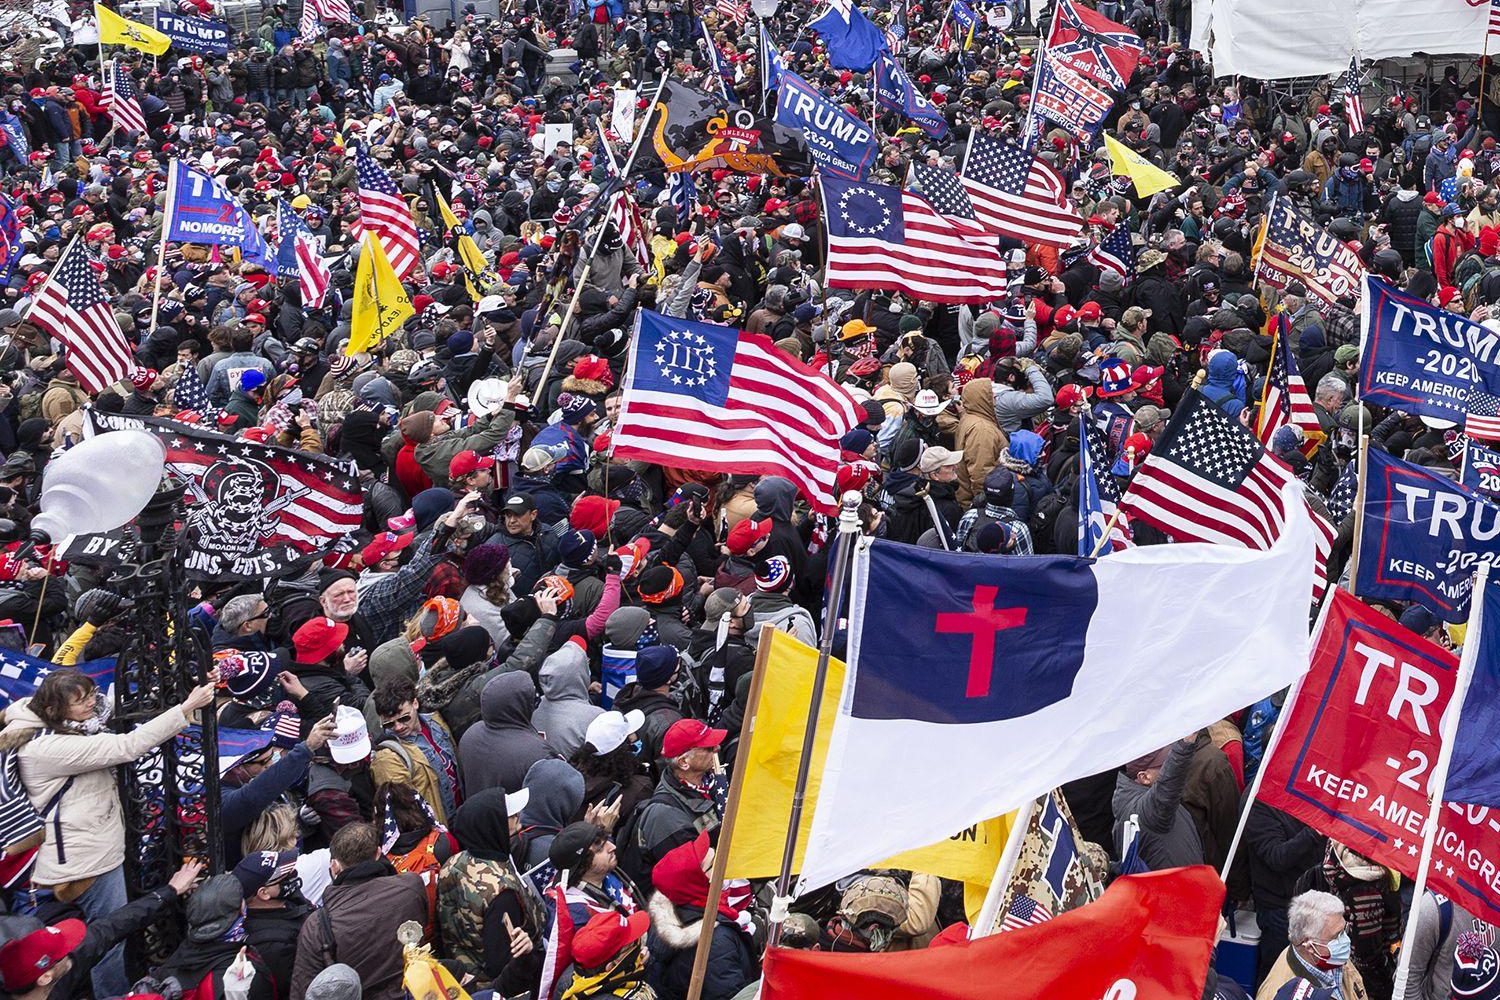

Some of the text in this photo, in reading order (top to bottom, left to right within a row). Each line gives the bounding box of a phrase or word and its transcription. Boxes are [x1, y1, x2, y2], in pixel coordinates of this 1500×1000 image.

[159, 17, 226, 40] TRUMP
[1073, 57, 1092, 73] and
[1093, 64, 1112, 83] Take
[878, 87, 896, 101] KEEP
[783, 84, 870, 146] TRUMP
[721, 128, 755, 140] UNLEASH
[831, 156, 857, 174] GREAT!
[1283, 206, 1361, 274] TRUM
[1288, 244, 1349, 296] 2020
[1376, 371, 1409, 387] KEEP
[82, 536, 120, 557] BY
[1389, 558, 1475, 599] KEEP AMERI
[1306, 764, 1369, 808] KEEP
